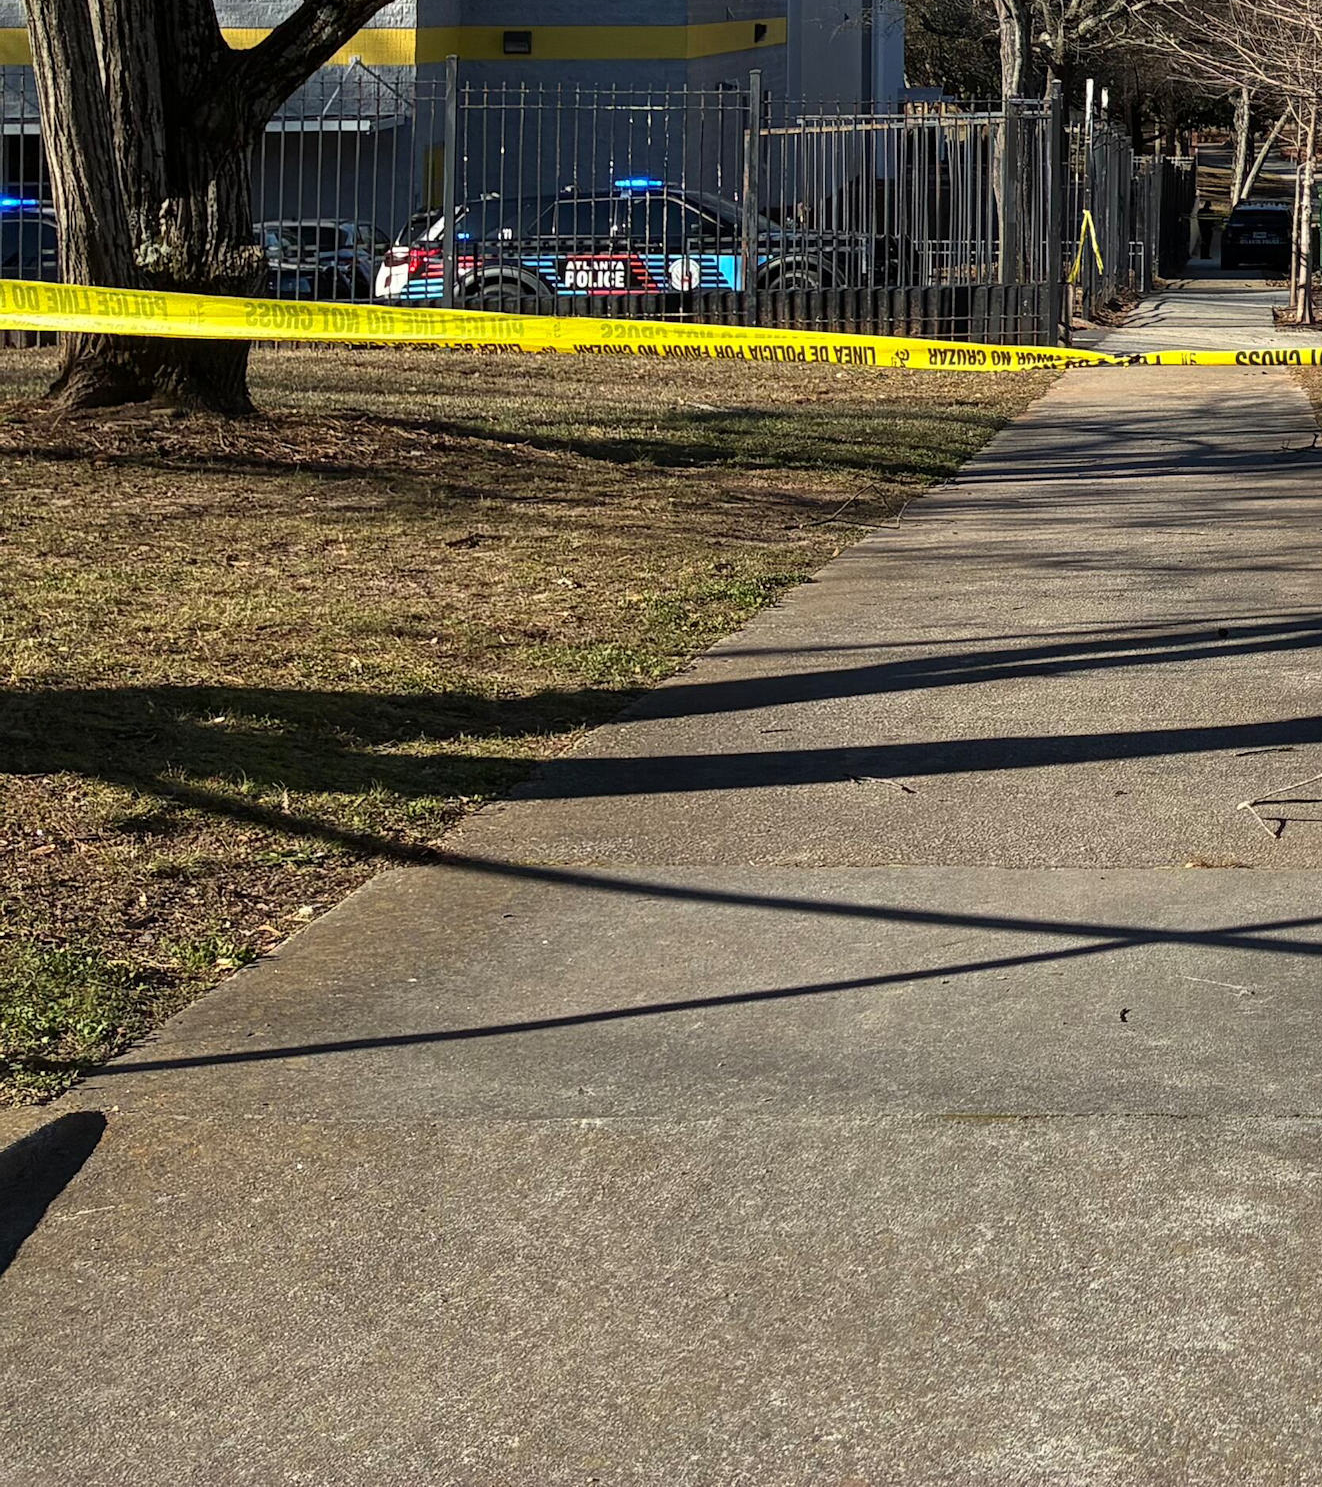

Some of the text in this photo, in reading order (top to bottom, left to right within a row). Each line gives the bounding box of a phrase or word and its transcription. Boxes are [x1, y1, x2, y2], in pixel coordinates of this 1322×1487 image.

[565, 261, 625, 270] ATLANTA
[565, 271, 625, 288] POLICE
[714, 344, 744, 359] POR
[751, 345, 806, 361] POLICIA
[810, 345, 830, 362] DE
[834, 346, 876, 364] LINEA
[928, 348, 985, 367] CRUZAR
[992, 350, 1011, 366] NO
